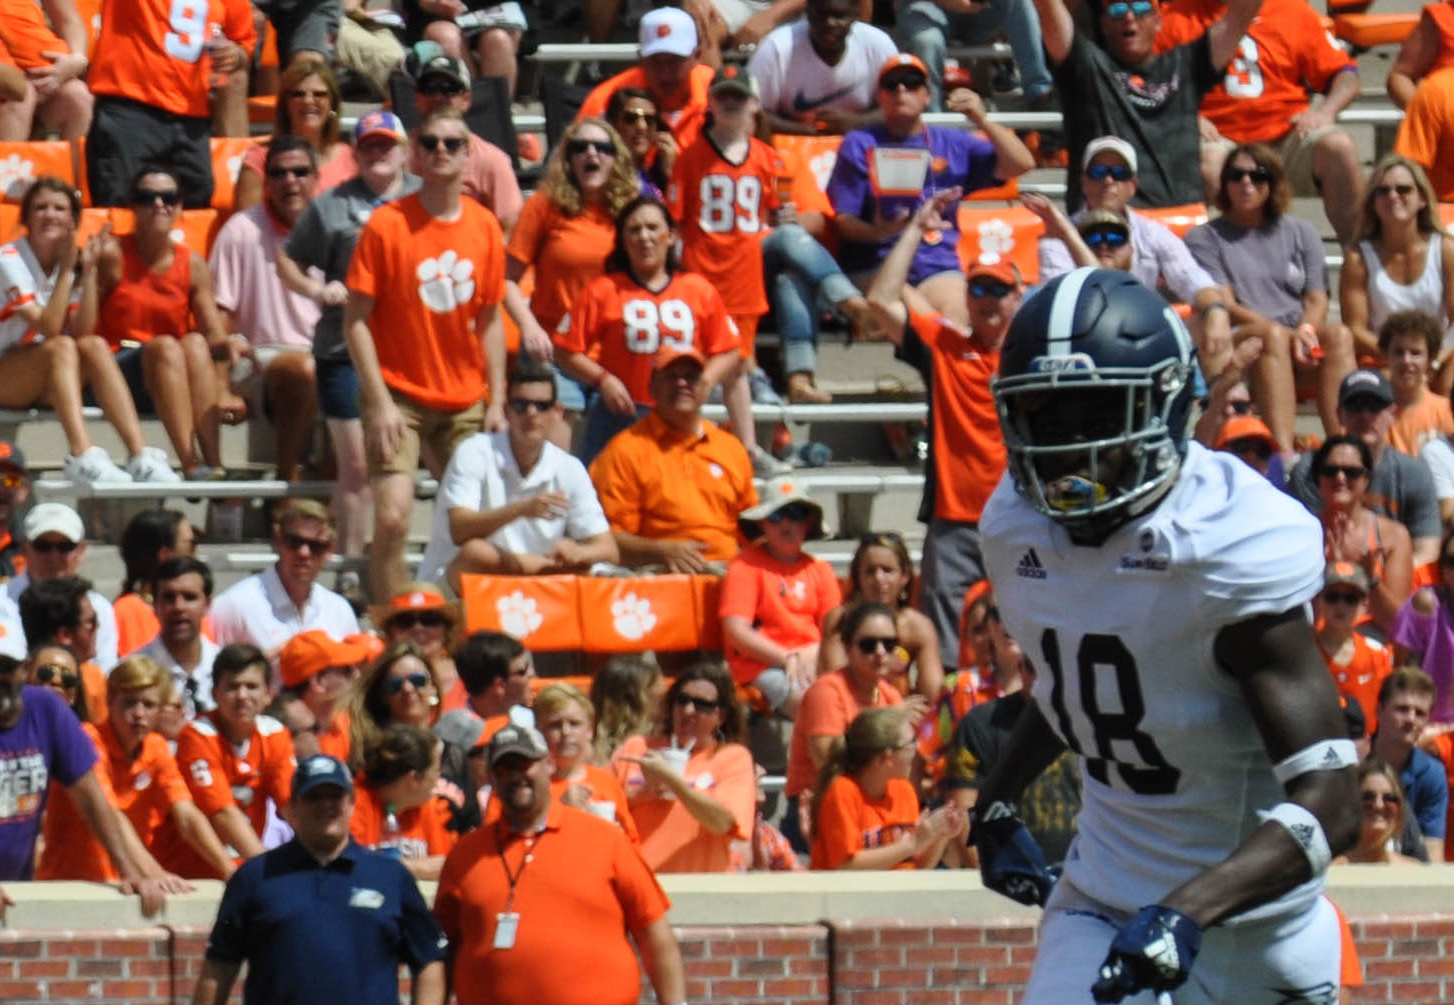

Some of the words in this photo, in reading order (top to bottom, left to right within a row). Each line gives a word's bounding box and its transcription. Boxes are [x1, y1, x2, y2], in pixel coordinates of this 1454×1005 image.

[164, 0, 207, 63] 9
[699, 174, 762, 233] 89
[623, 299, 694, 354] 89
[1041, 627, 1182, 795] 18
